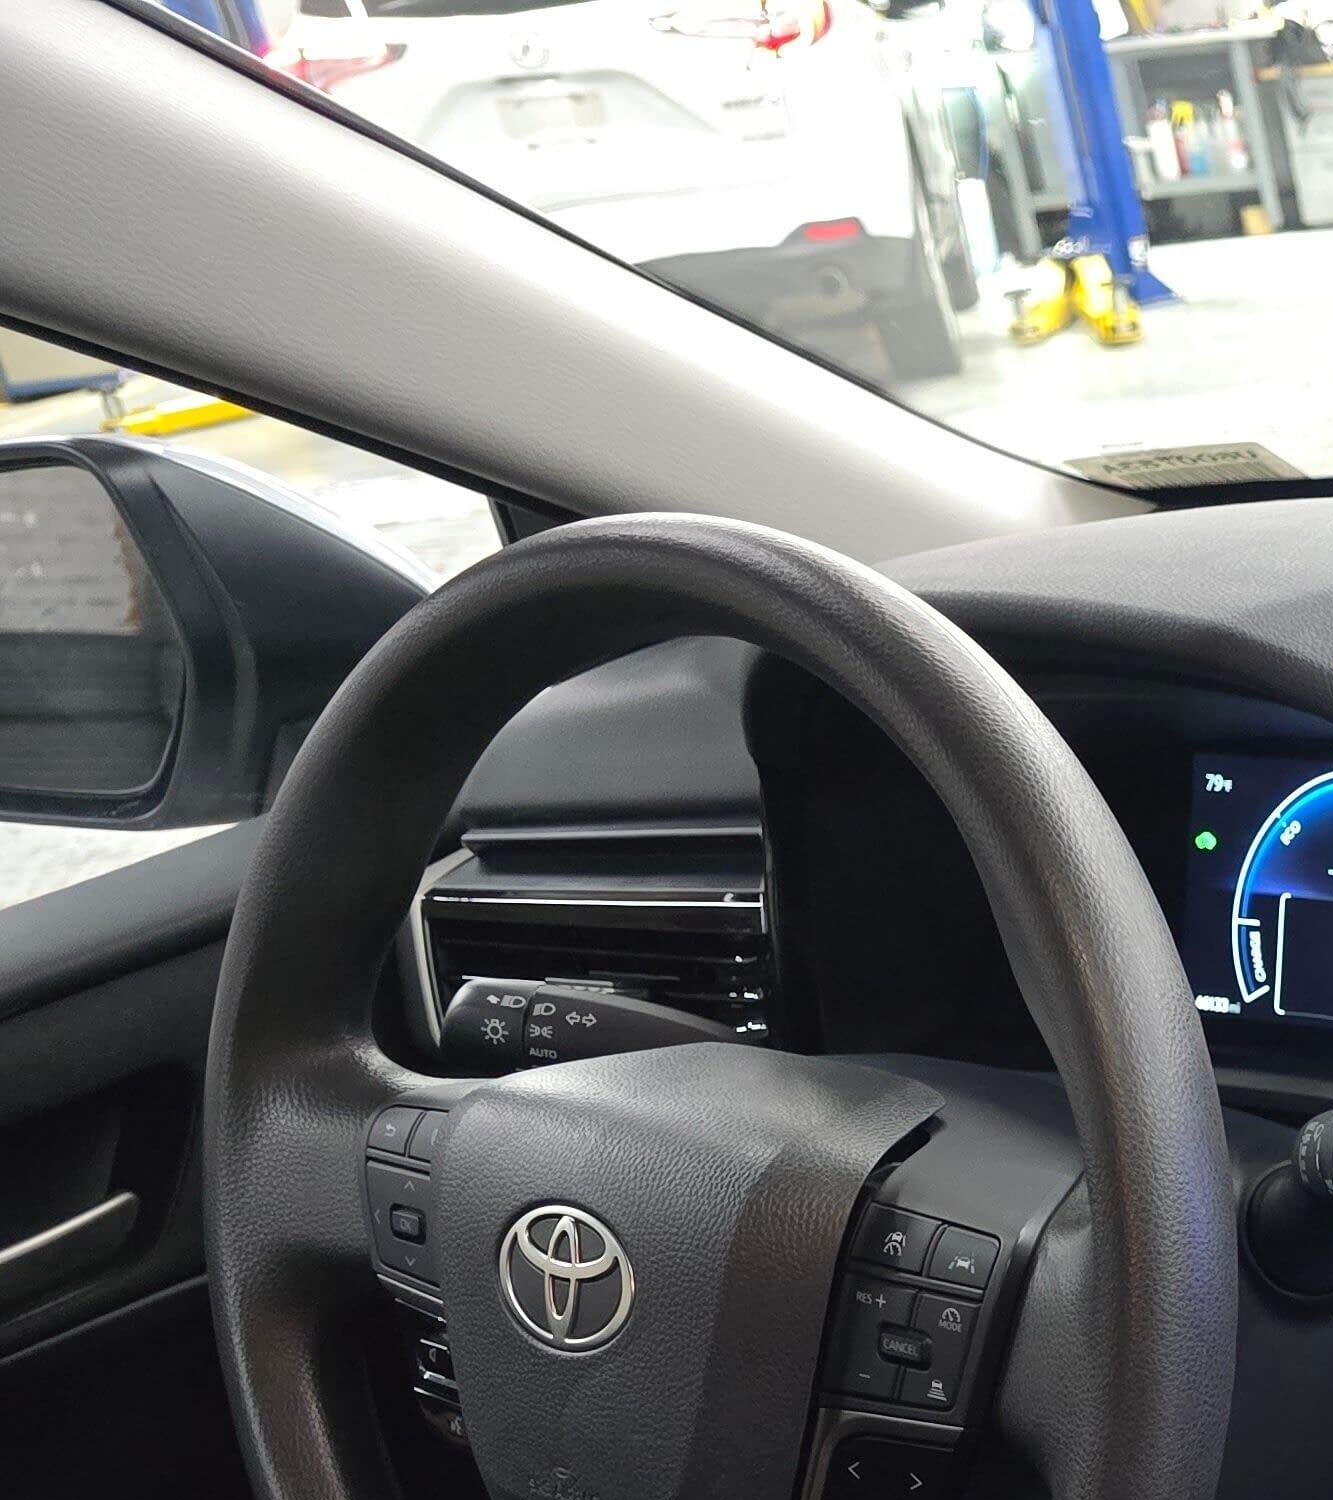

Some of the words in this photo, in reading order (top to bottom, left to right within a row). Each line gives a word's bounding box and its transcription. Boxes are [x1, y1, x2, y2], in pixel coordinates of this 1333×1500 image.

[529, 1047, 558, 1060] AUTO
[856, 1290, 873, 1305] RES
[937, 1319, 963, 1333] MODE
[882, 1338, 919, 1358] CANCEL
